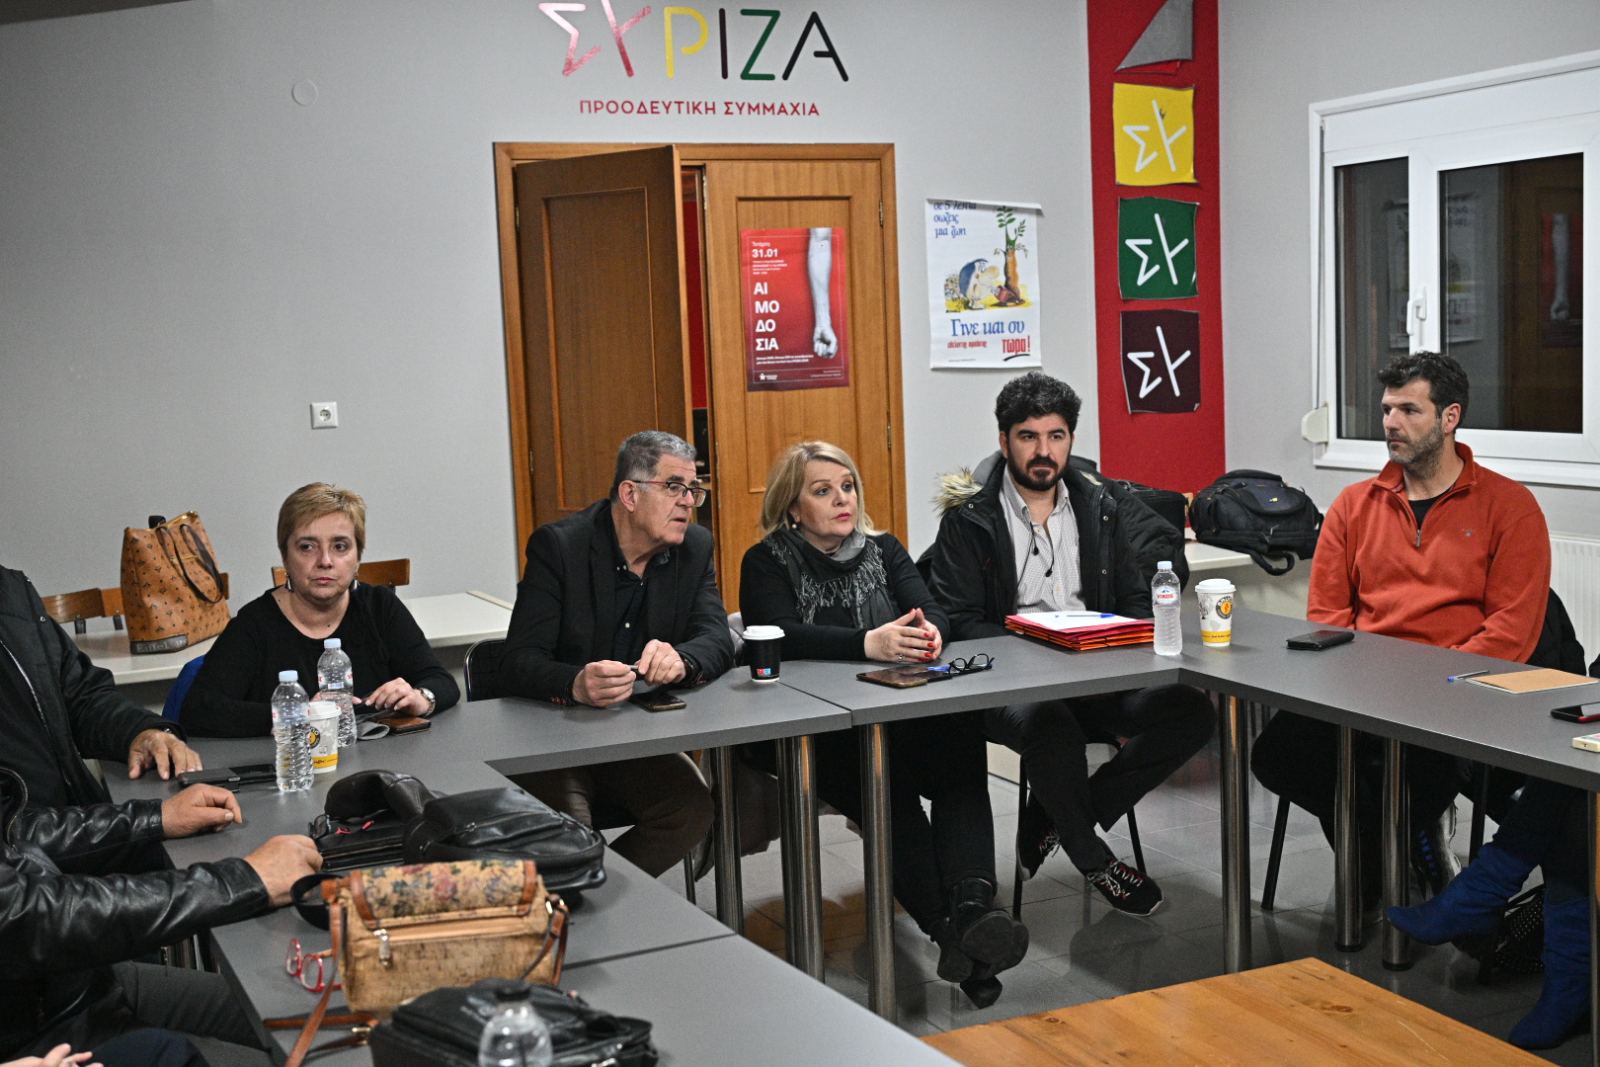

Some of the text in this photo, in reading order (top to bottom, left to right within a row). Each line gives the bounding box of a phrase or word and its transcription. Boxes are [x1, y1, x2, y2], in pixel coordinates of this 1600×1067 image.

[538, 0, 849, 81] ΣΥΡΙΖΑ
[579, 100, 820, 116] ΠΡΟΟΔΕΥΤΙΚΗ ΣΥΜΜΑΧΙΑ
[752, 248, 778, 258] 31.01
[754, 282, 768, 295] ΑΙ
[755, 300, 780, 314] ΜΟ
[755, 319, 776, 333] ΔΟ
[755, 337, 779, 351] ΣΙΑ
